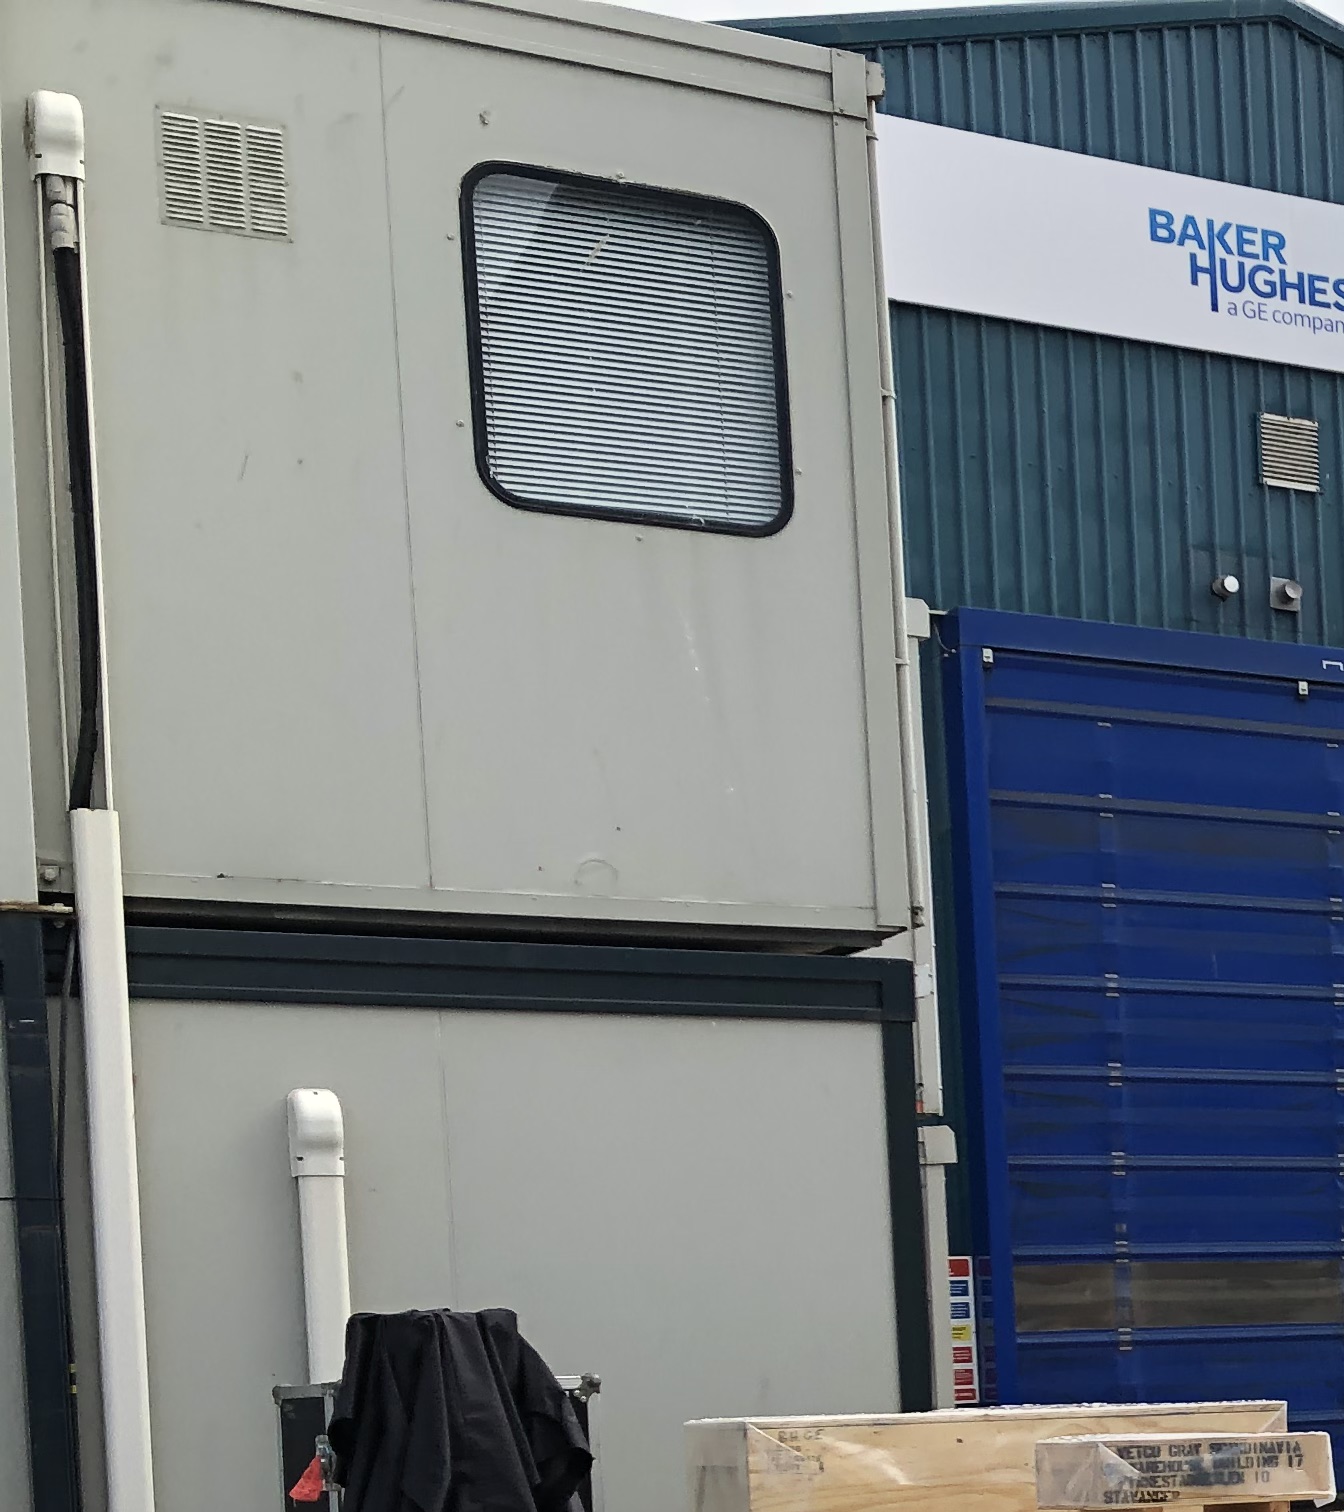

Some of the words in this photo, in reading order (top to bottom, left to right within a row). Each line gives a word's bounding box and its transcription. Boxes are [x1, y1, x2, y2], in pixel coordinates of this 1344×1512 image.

[1148, 206, 1288, 266] BAKER
[1227, 302, 1238, 317] a
[1242, 301, 1269, 322] GE
[1287, 1453, 1304, 1468] 17
